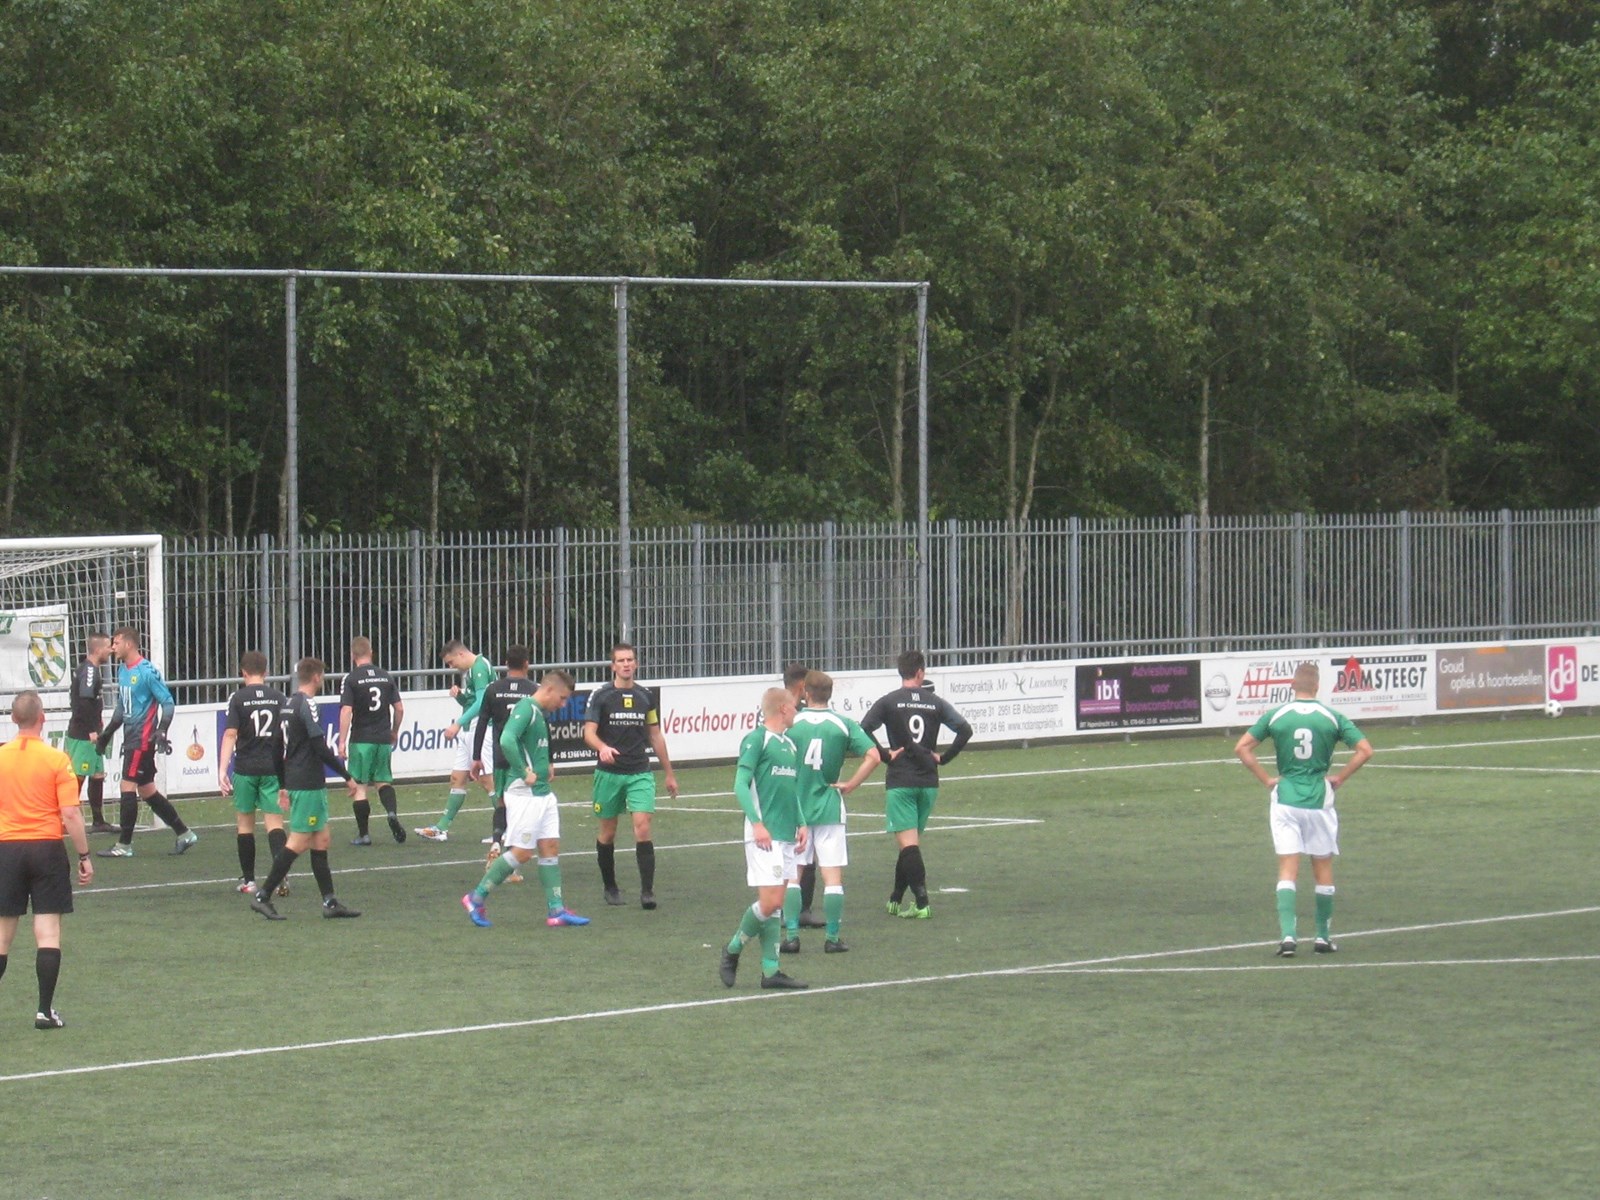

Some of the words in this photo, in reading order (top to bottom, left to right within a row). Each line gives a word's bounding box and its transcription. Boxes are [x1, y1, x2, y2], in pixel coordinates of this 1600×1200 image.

[1439, 657, 1465, 673] Goud
[1550, 654, 1575, 694] da
[1581, 664, 1599, 682] DE
[1097, 679, 1120, 700] ibt
[1337, 666, 1428, 692] DAMSTEEGT
[368, 686, 382, 712] 3
[843, 698, 853, 712] &
[250, 709, 273, 737] 12
[663, 706, 737, 734] Verschoor
[908, 714, 925, 744] 9
[392, 719, 460, 752] oban
[1294, 728, 1313, 760] 3
[804, 738, 823, 771] 4
[182, 766, 210, 776] Rabobank
